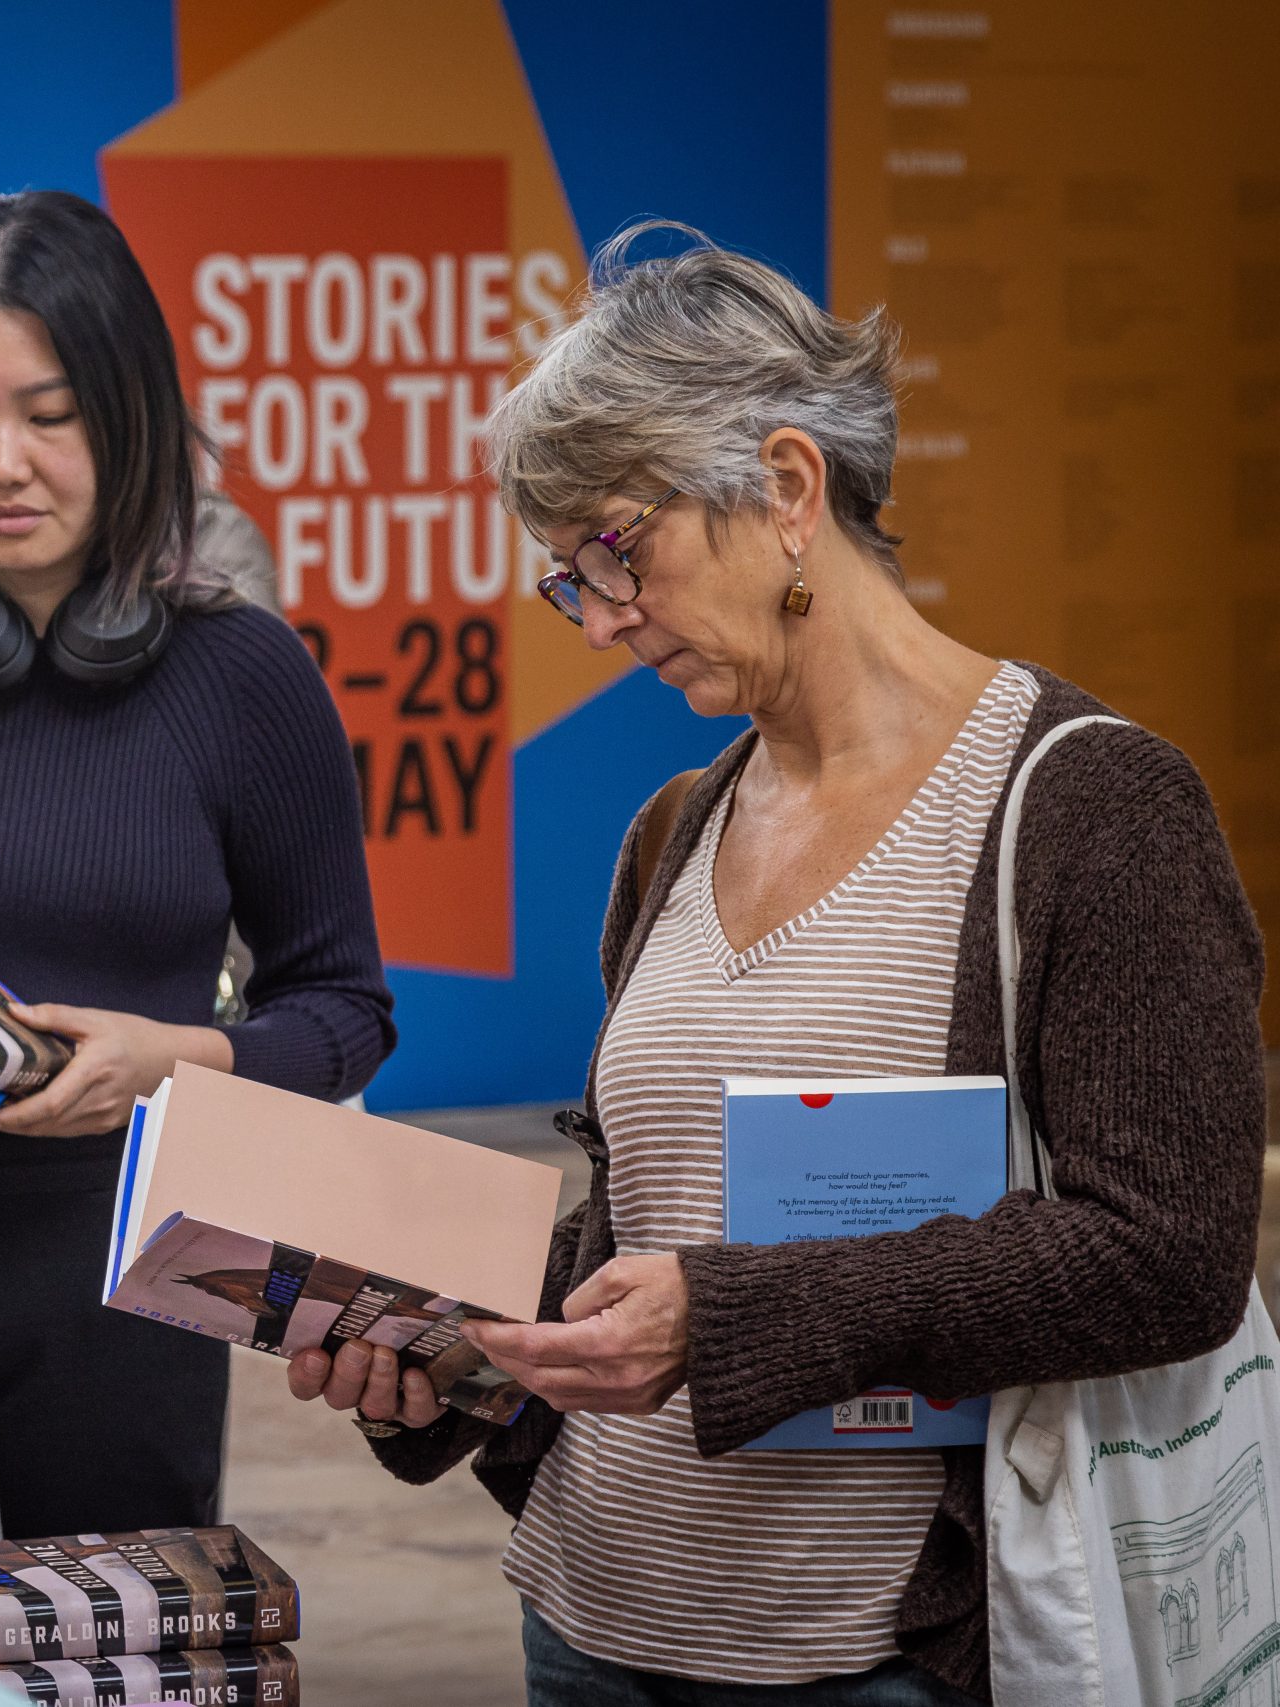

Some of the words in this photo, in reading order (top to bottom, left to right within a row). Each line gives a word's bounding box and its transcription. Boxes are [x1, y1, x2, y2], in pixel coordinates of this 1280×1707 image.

[192, 250, 570, 369] STORIES
[197, 372, 370, 490] FOR
[388, 372, 508, 484] TH
[805, 1173, 811, 1181] If
[828, 1172, 849, 1180] could
[850, 1172, 871, 1180] touch
[873, 1173, 890, 1181] your
[845, 1182, 869, 1190] would
[870, 1182, 887, 1191] they
[888, 1182, 908, 1191] feel?
[133, 1306, 206, 1332] HORSE
[332, 1285, 399, 1339] GERALDINE
[22, 1543, 108, 1589] GERALDINE
[117, 1543, 173, 1579] BROOKS
[4, 1618, 135, 1646] GERALDINE
[147, 1611, 236, 1636] BROOKS
